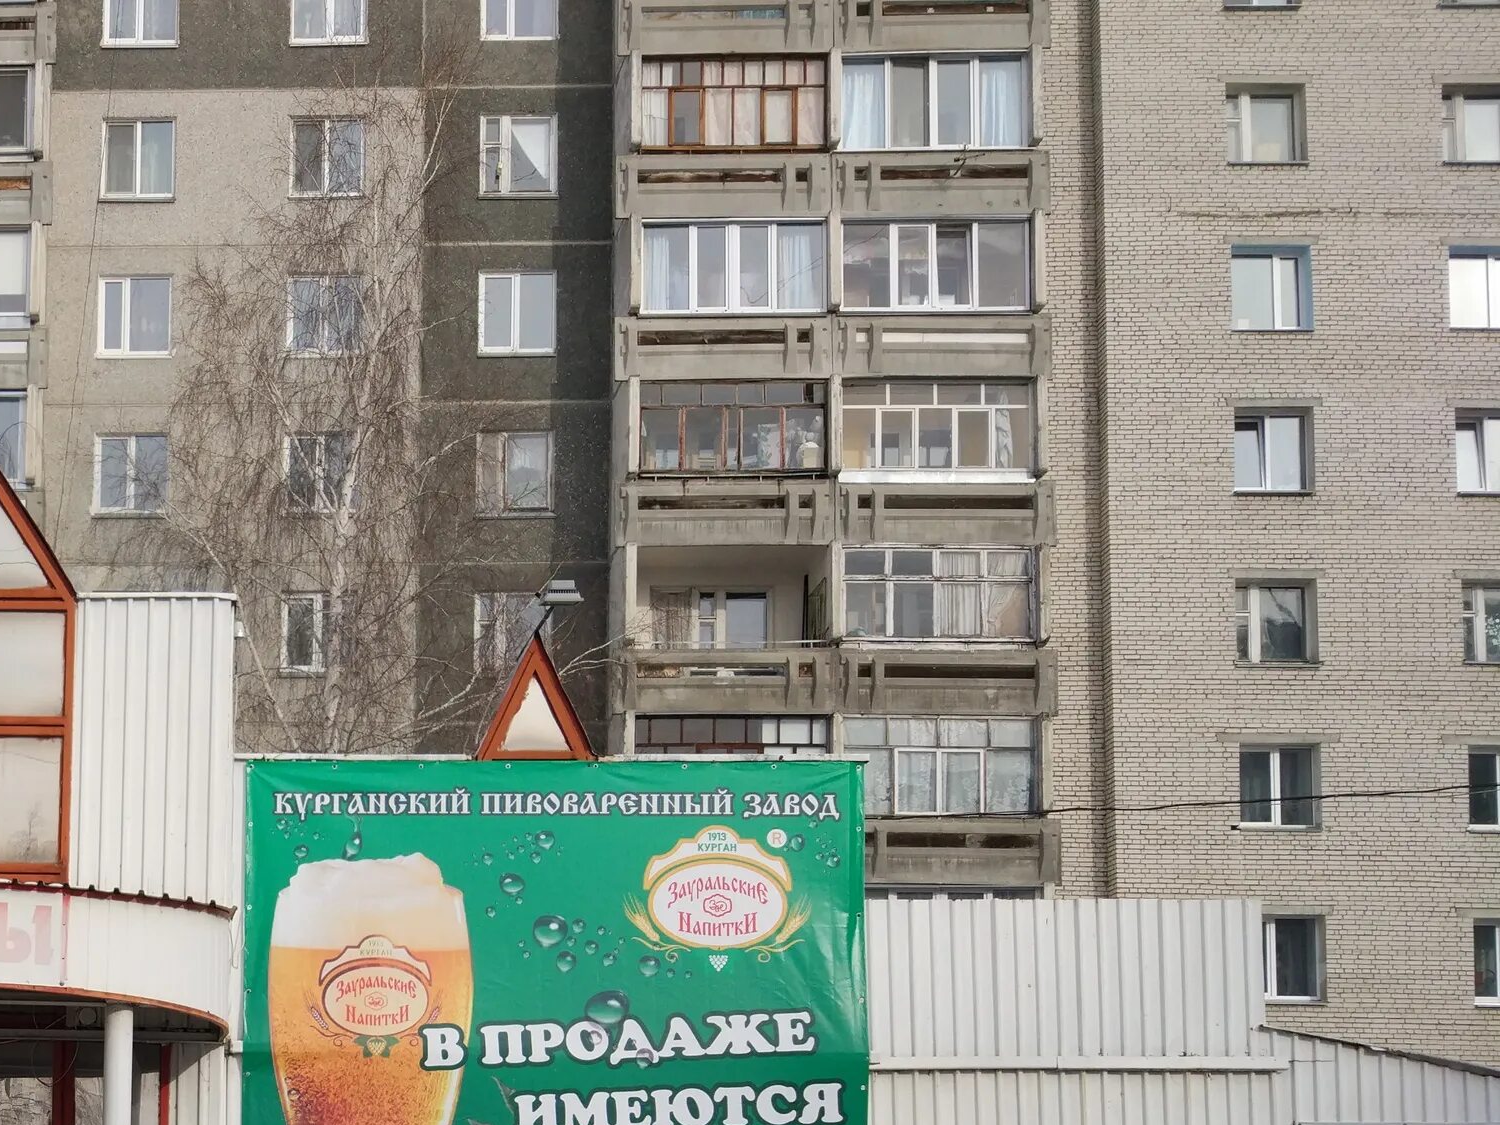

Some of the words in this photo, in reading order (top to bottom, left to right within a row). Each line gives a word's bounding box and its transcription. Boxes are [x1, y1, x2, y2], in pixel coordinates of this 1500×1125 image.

[273, 788, 471, 823] КУРГАНСКИЙ
[481, 787, 734, 818] ПИВОВАРЕННЫЙ
[742, 793, 842, 821] ЗАВОД
[697, 843, 737, 852] КУРГАН
[707, 832, 727, 841] 1913
[422, 1026, 464, 1068] В
[480, 1010, 816, 1066] ПРОДАЖЕ
